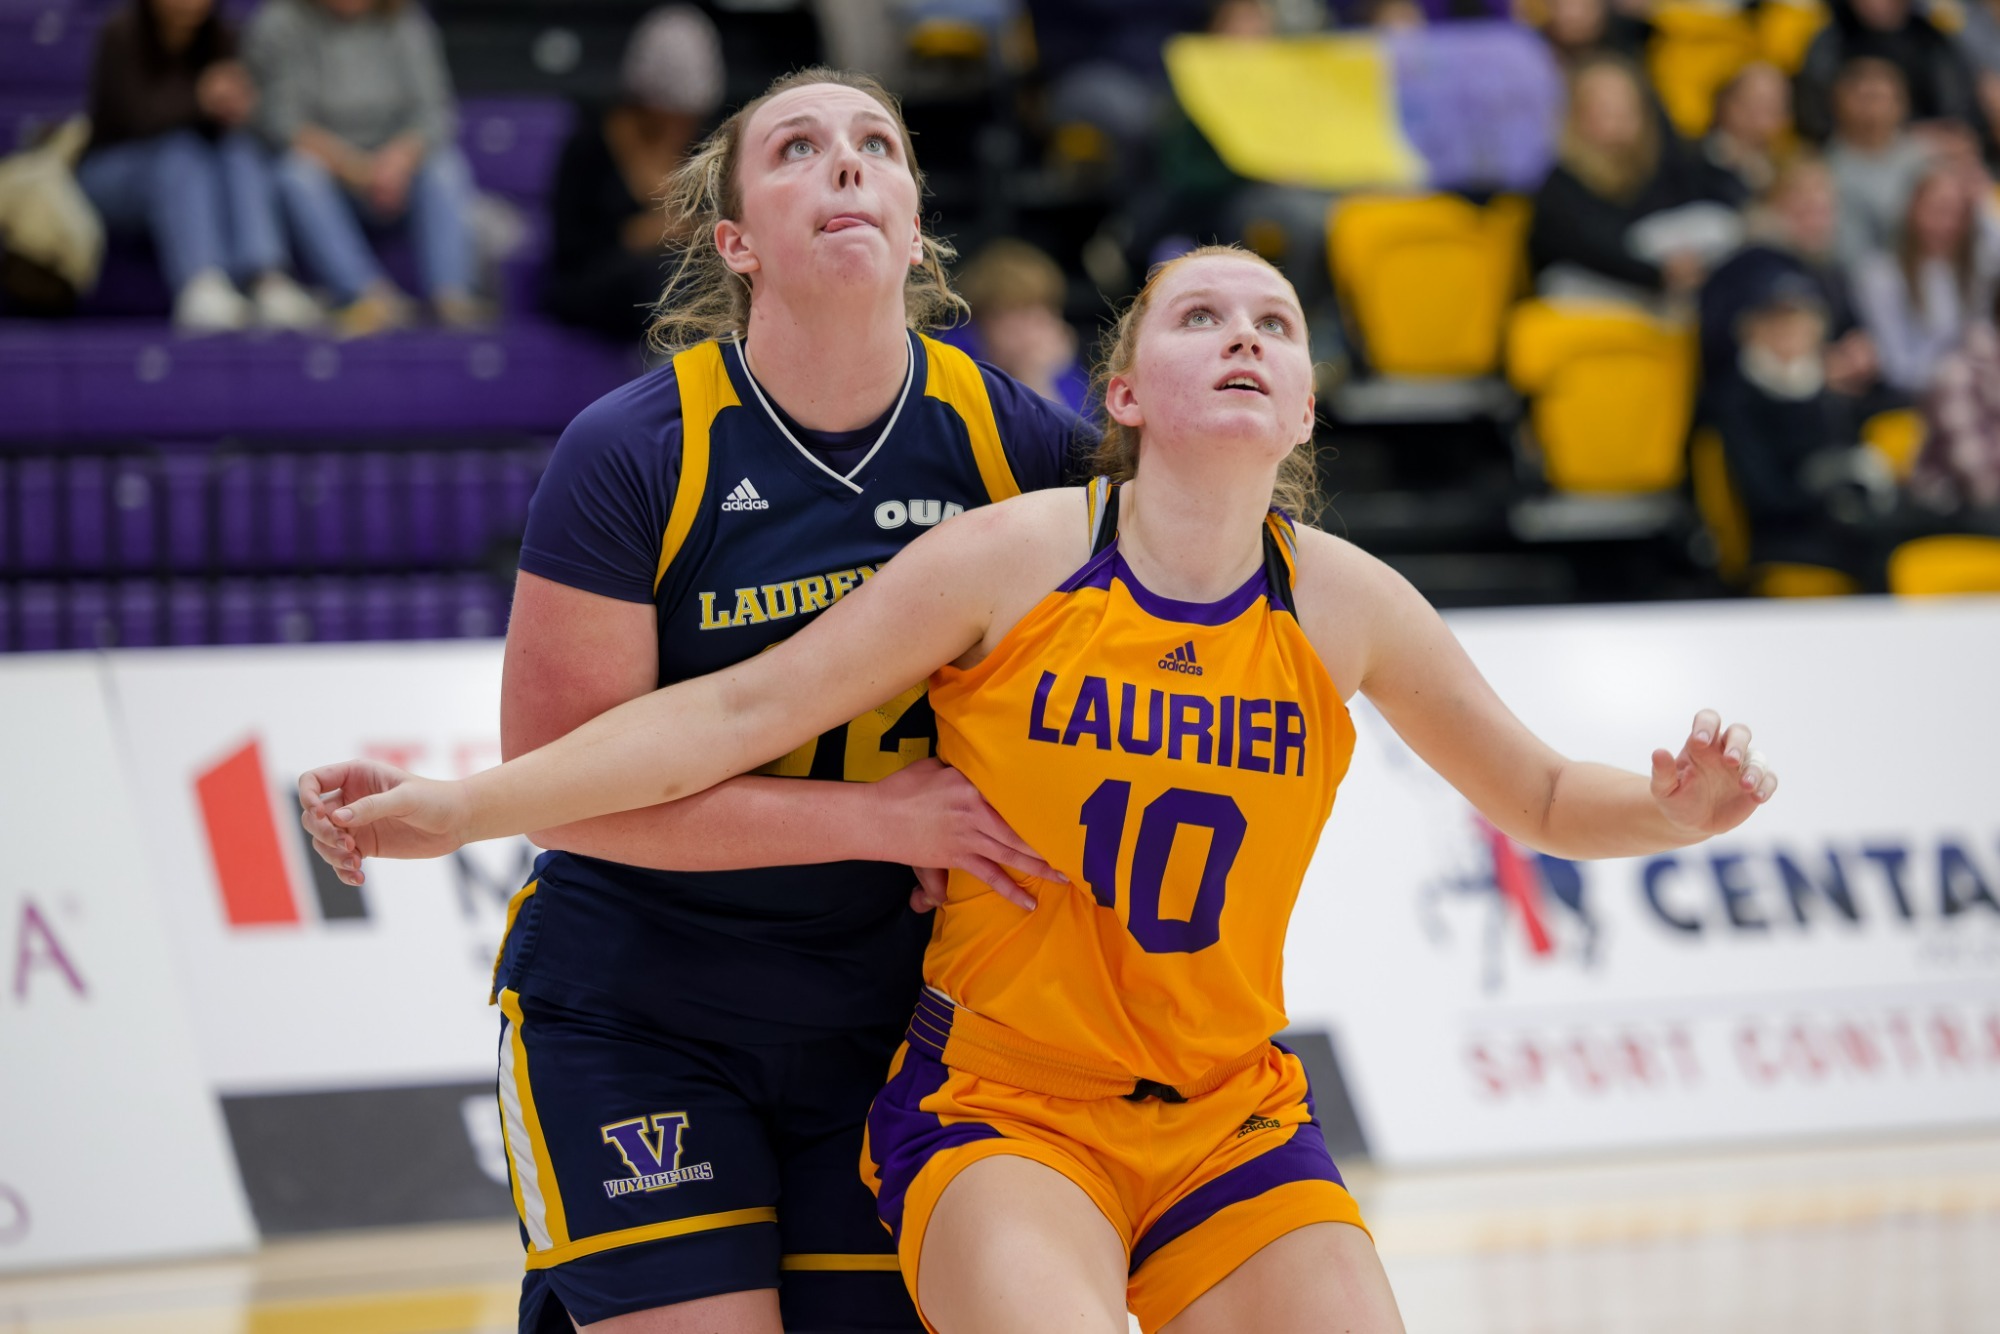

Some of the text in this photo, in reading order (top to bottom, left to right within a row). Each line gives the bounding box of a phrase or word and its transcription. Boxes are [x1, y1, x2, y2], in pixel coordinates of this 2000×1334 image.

[721, 498, 770, 512] adidas
[1157, 657, 1204, 677] adidas
[1028, 670, 1307, 777] LAURIER
[1078, 778, 1248, 955] 10
[1236, 1118, 1281, 1139] adidas
[603, 1161, 714, 1199] VOYAGEURS
